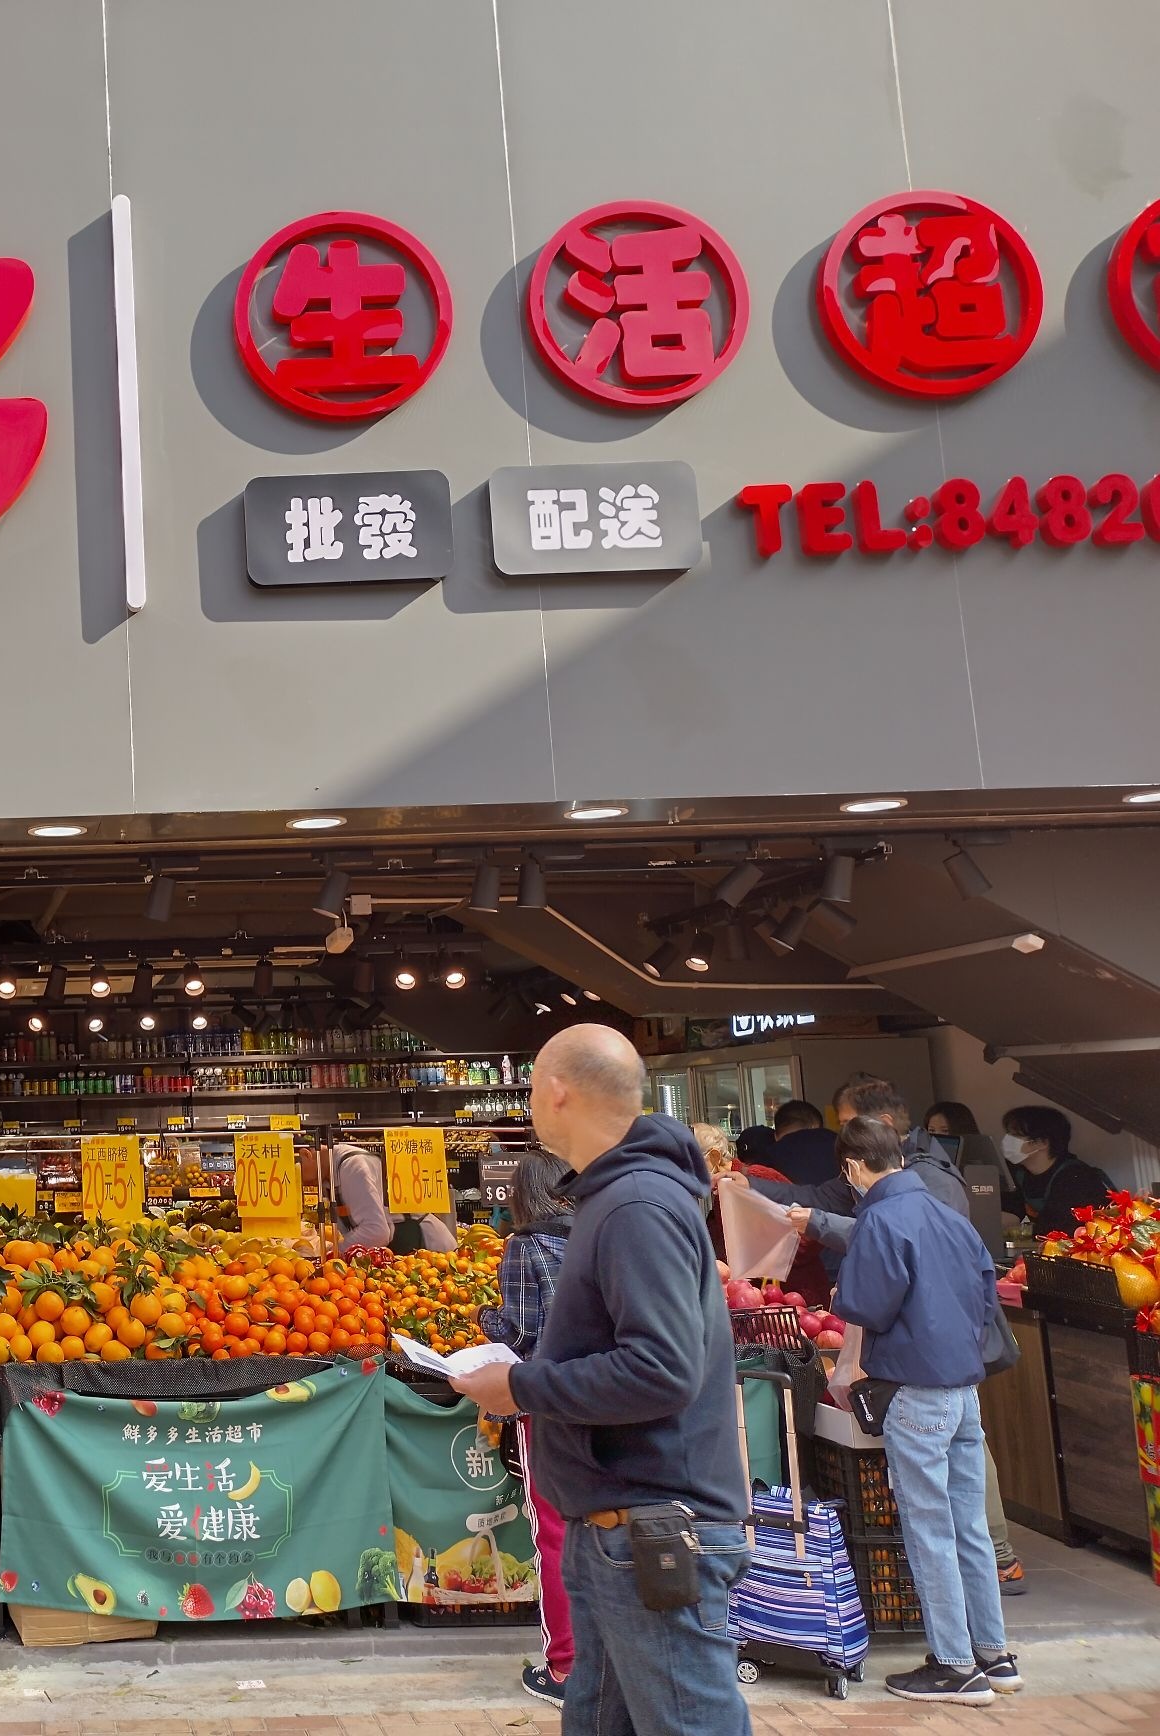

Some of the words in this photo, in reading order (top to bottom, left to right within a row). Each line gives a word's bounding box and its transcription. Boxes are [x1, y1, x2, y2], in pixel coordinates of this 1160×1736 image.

[260, 200, 1160, 390] 生活超
[284, 493, 418, 563] 批發
[526, 484, 663, 550] 配送
[241, 1143, 282, 1159] 沃柑
[83, 1161, 136, 1210] 20元5个
[237, 1158, 291, 1208] 20元6个
[141, 1457, 237, 1493] 爱生活
[156, 1502, 261, 1542] 爱健康
